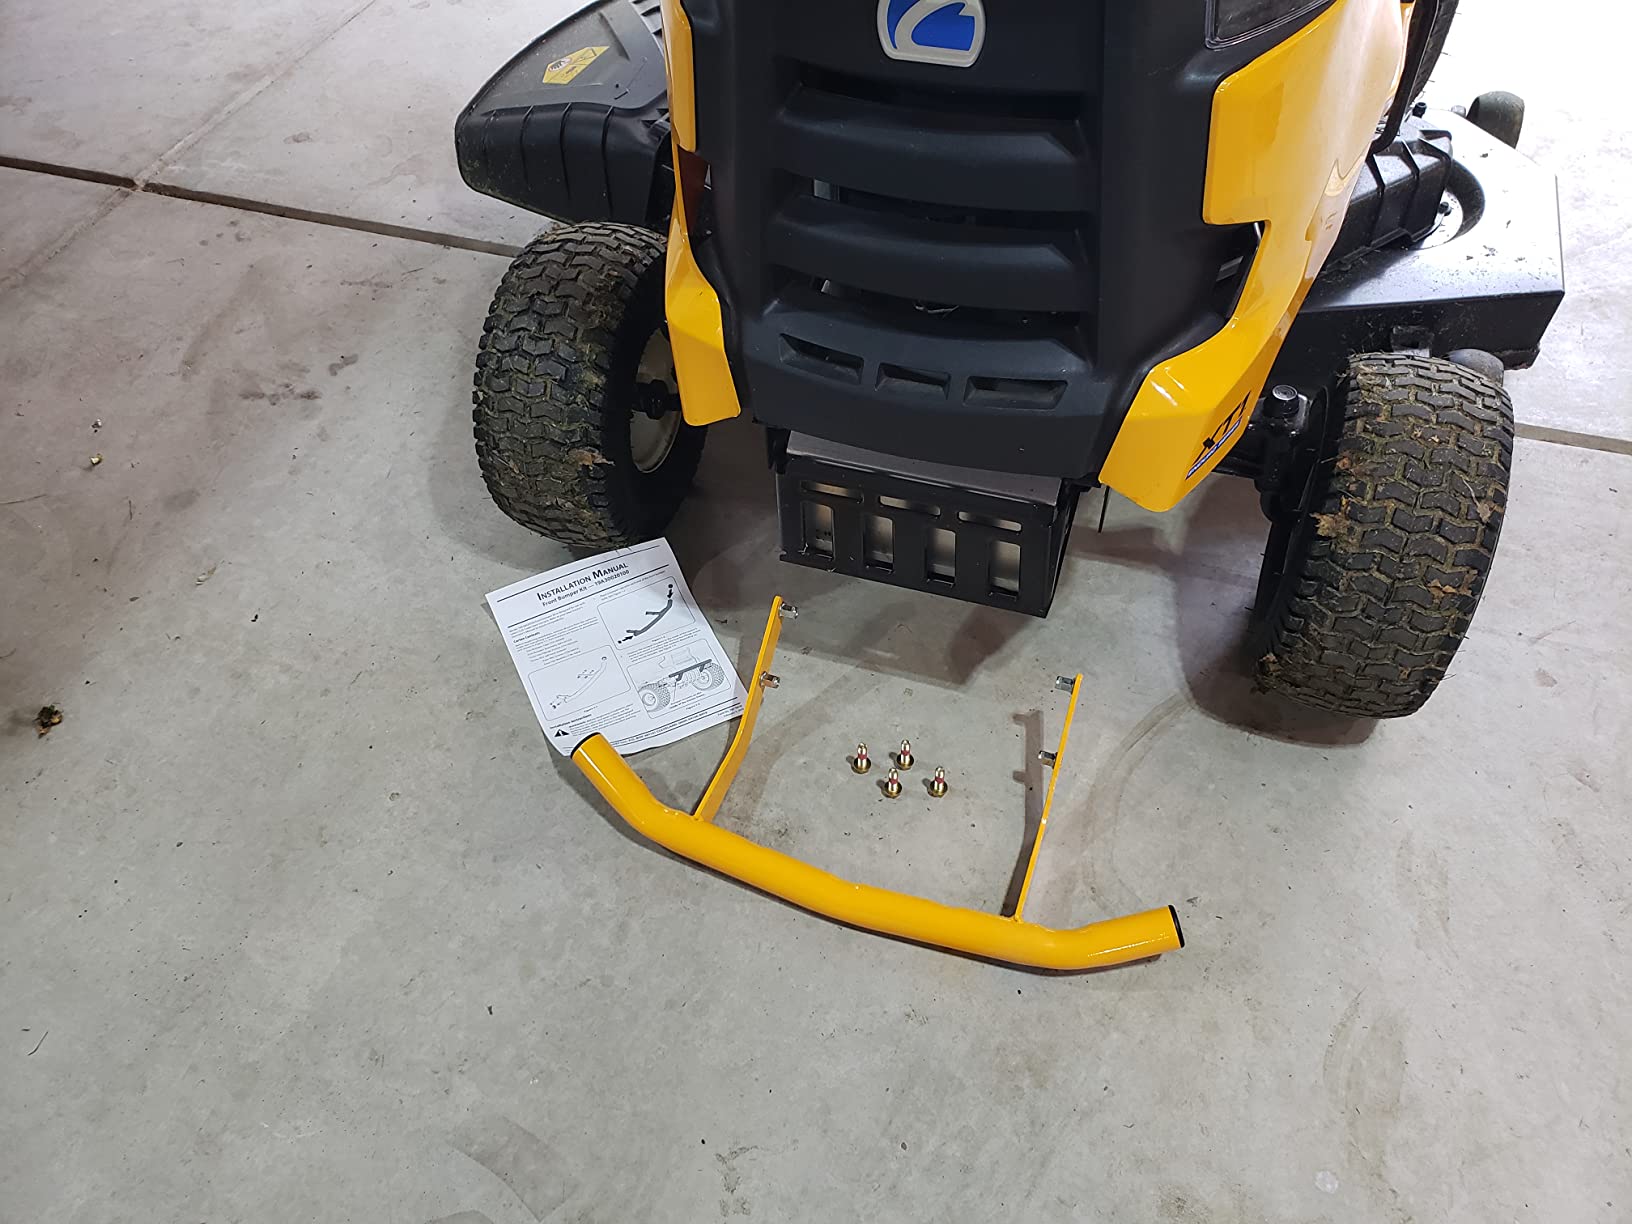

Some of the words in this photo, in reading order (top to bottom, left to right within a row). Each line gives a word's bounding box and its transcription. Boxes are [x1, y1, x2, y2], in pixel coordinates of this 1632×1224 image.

[536, 575, 592, 601] INSTALLATION
[592, 562, 629, 579] MANUAL
[542, 598, 558, 607] Front
[557, 589, 579, 601] Bumper
